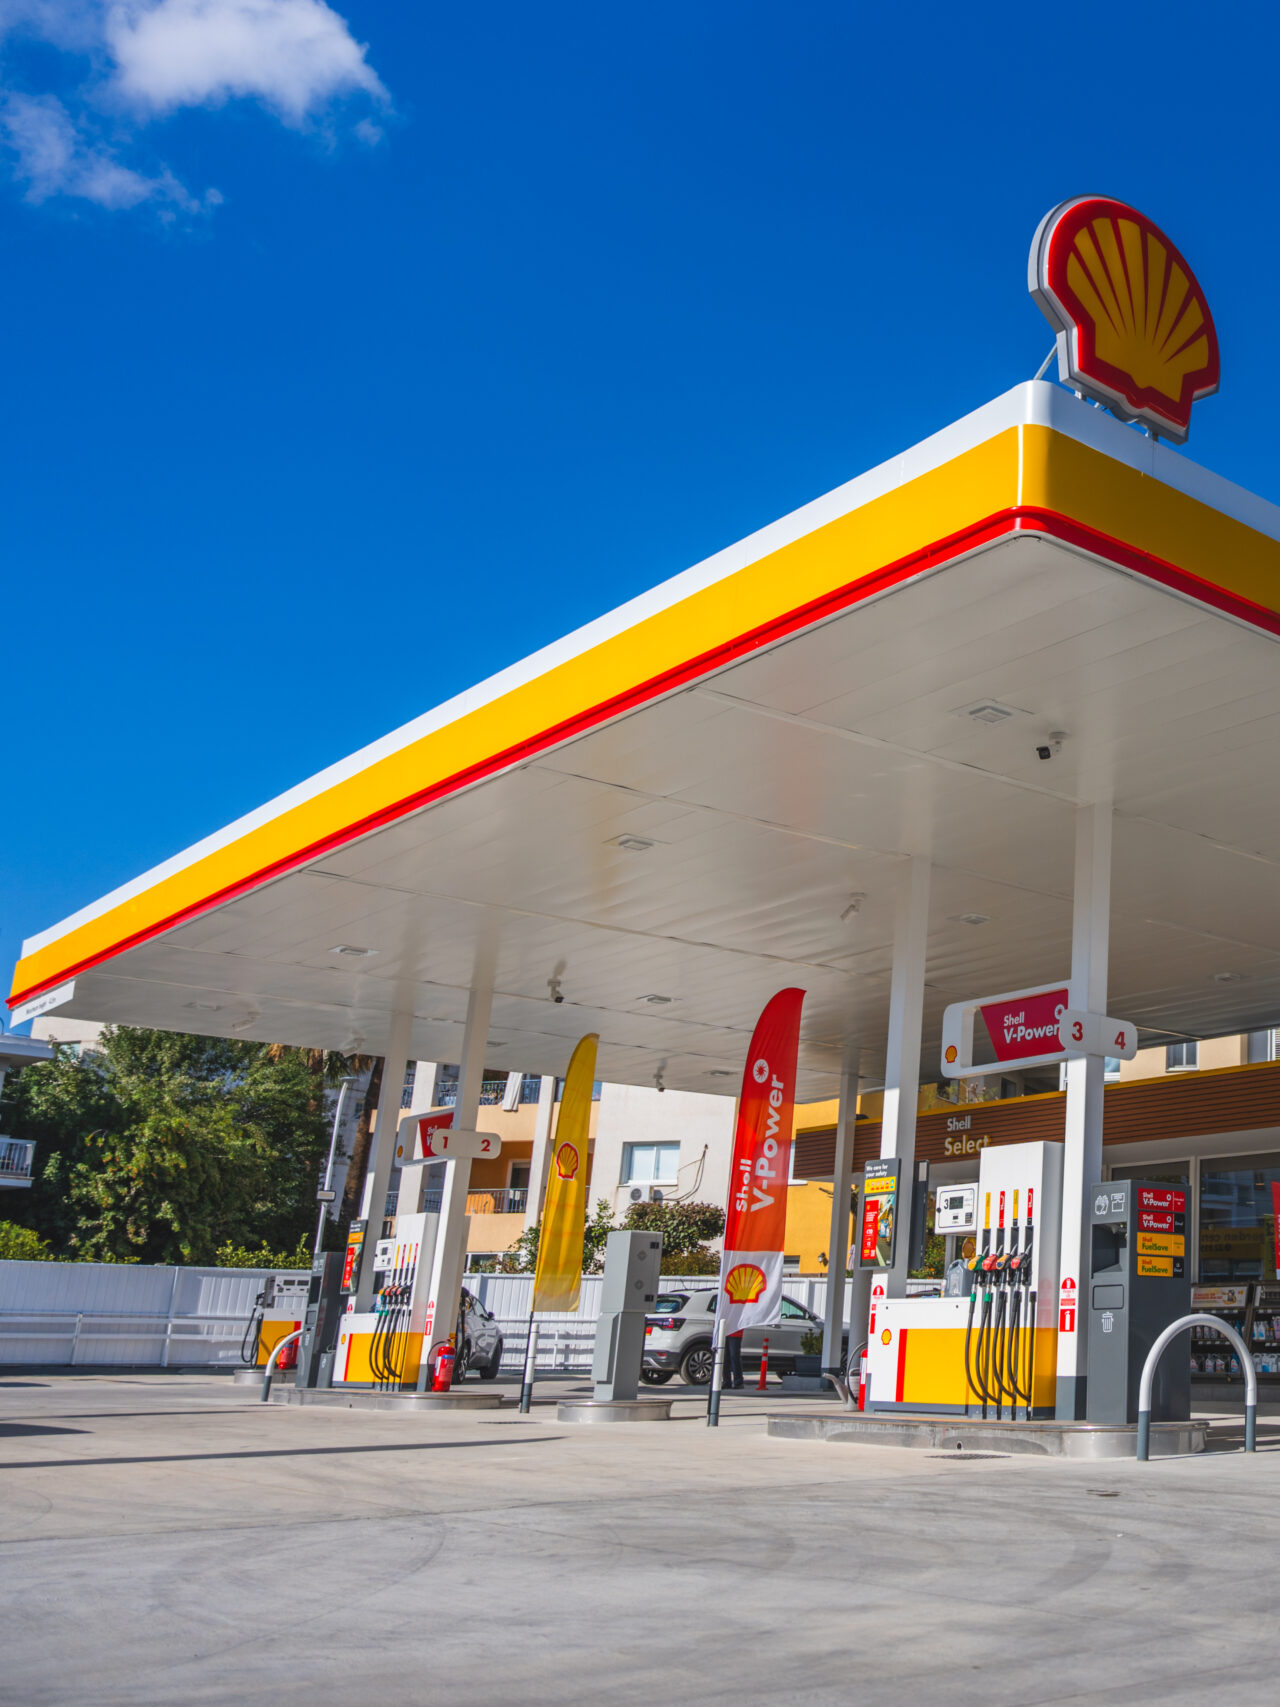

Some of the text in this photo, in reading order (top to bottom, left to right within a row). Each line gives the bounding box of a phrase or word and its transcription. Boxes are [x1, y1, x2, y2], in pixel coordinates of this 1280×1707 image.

[1003, 1011, 1025, 1027] Shell
[1003, 1024, 1060, 1044] V-Power
[1072, 1021, 1083, 1042] 3
[1114, 1031, 1126, 1050] 4
[946, 1115, 972, 1132] Shell
[442, 1136, 449, 1149] 1
[480, 1139, 491, 1152] 2
[750, 1074, 785, 1213] V-Power
[944, 1134, 989, 1156] Select
[735, 1158, 752, 1213] Shell
[943, 1198, 949, 1210] 3
[1142, 1198, 1170, 1207] V-Power
[1142, 1220, 1170, 1229] V-Power
[1141, 1242, 1169, 1251] FuelSave
[1141, 1264, 1169, 1274] FuelSave
